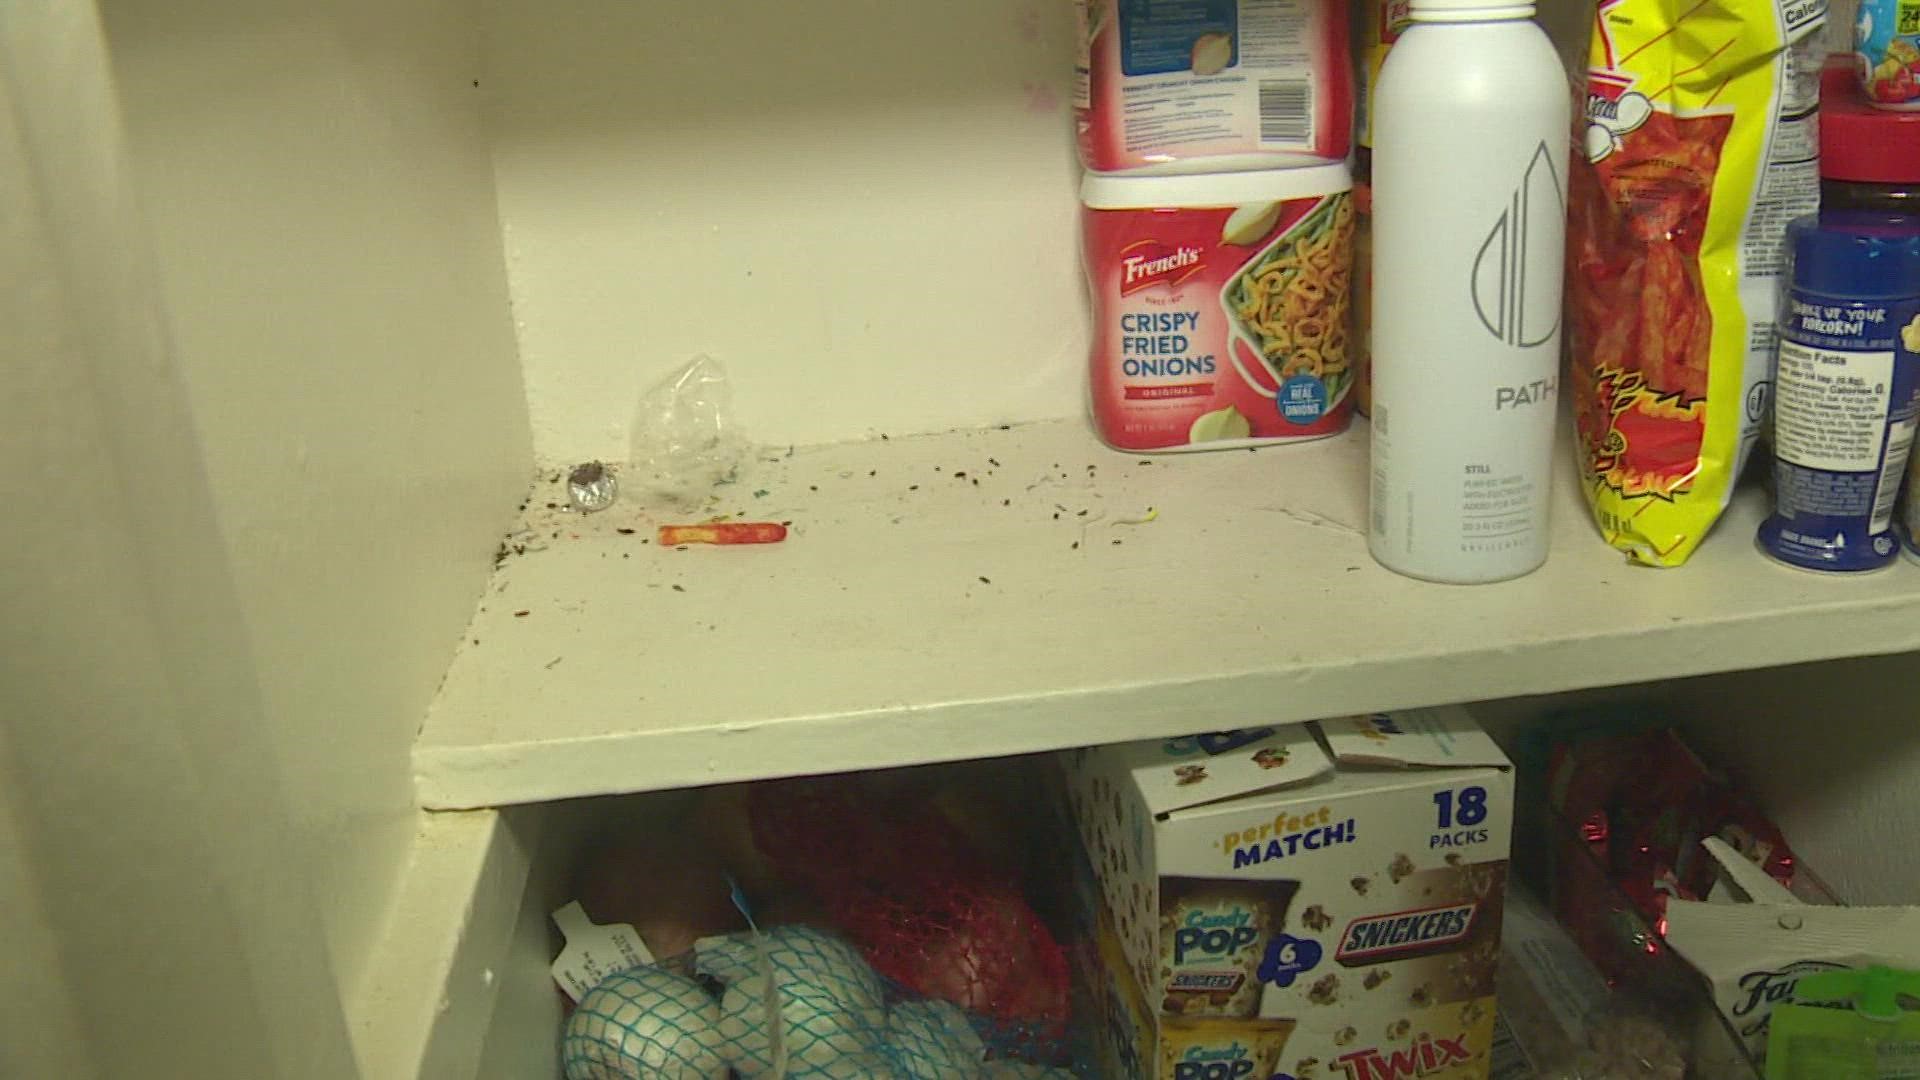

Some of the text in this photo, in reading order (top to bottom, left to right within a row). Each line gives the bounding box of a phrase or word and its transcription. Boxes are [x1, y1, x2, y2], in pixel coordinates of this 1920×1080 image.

[1123, 247, 1200, 284] French's
[1121, 311, 1200, 332] CRISPY
[1846, 308, 1886, 323] YOUR
[1122, 335, 1188, 355] FRIED
[1122, 355, 1216, 376] ONIONS
[1814, 352, 1847, 365] Facts
[1496, 377, 1556, 410] PATH
[1464, 465, 1490, 475] STILL
[1433, 785, 1488, 829] 18
[1223, 807, 1331, 853] perfect
[1430, 829, 1489, 849] PACKS
[1233, 818, 1356, 869] MATCH!
[1185, 907, 1250, 928] Candy
[1345, 906, 1472, 953] SNICKERS
[1174, 926, 1258, 966] POP
[1279, 943, 1297, 963] 6
[1185, 1041, 1249, 1061] Candy
